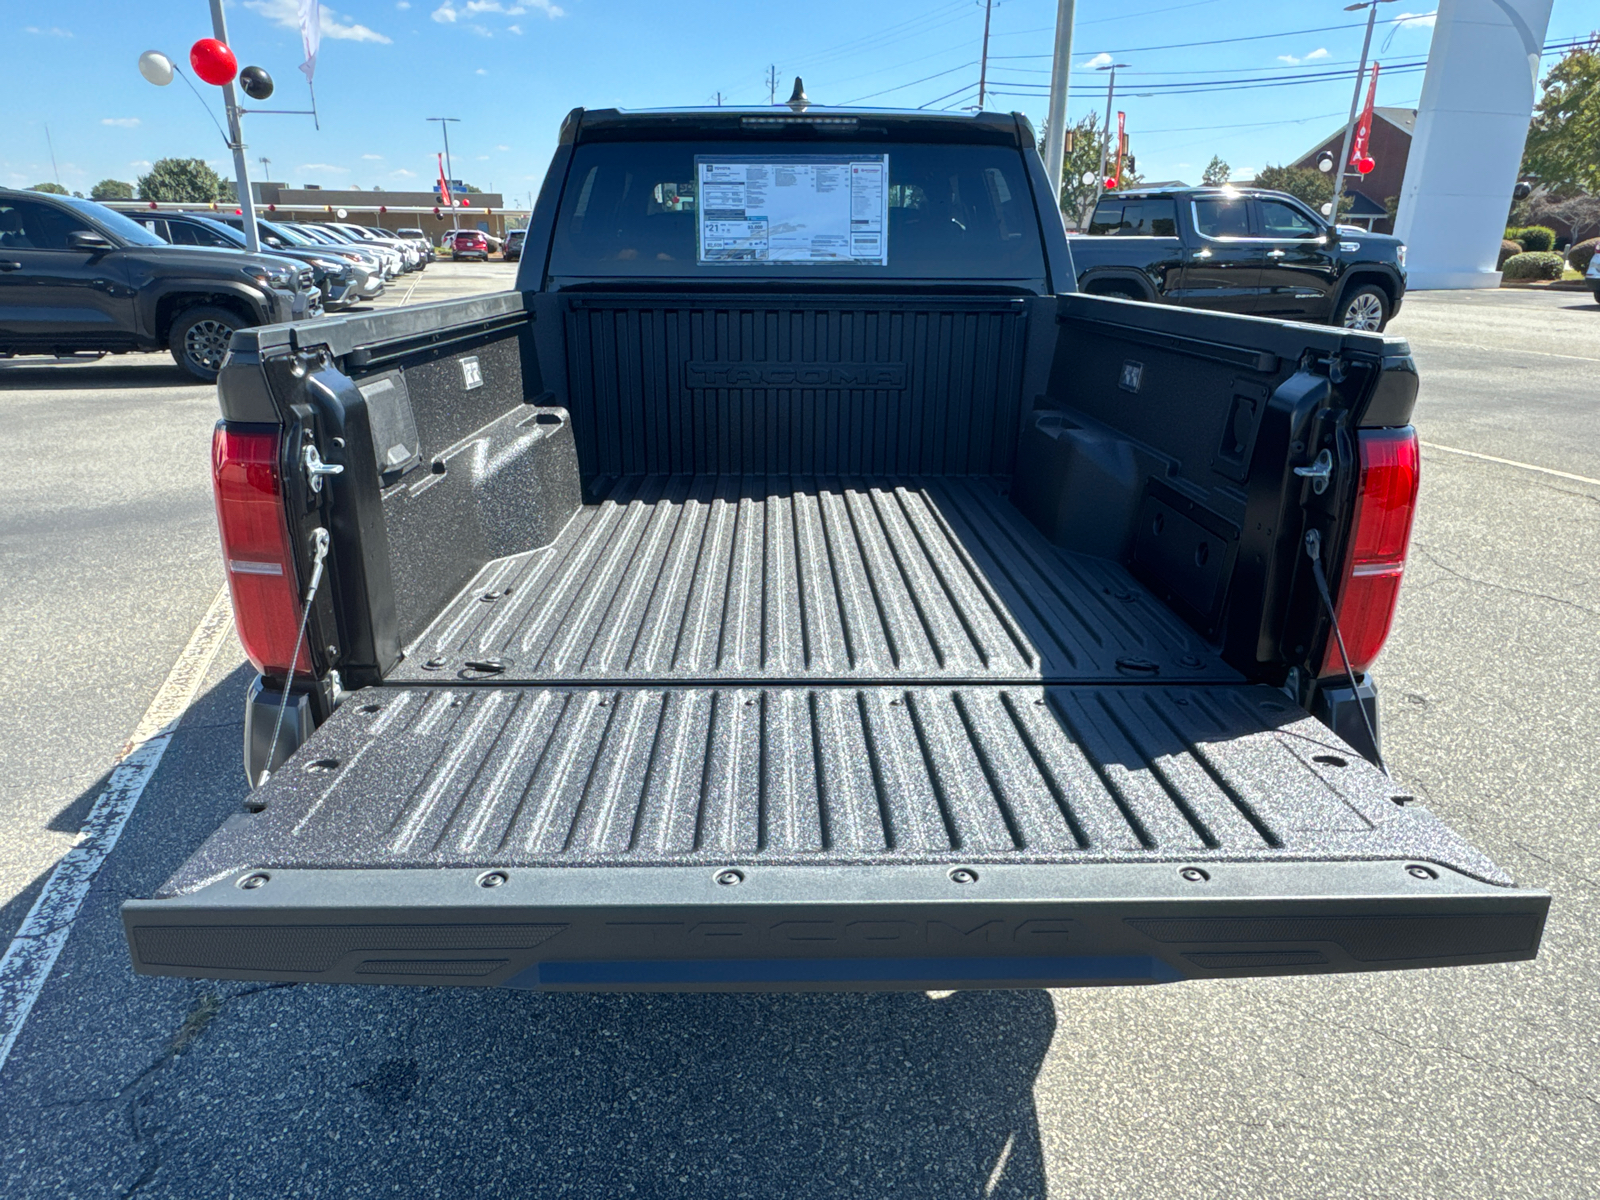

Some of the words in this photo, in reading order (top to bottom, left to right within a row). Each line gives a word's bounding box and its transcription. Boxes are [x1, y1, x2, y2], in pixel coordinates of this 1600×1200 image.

[708, 224, 719, 232] 21
[690, 367, 902, 385] TACOMA
[605, 918, 1083, 943] TACOMA
